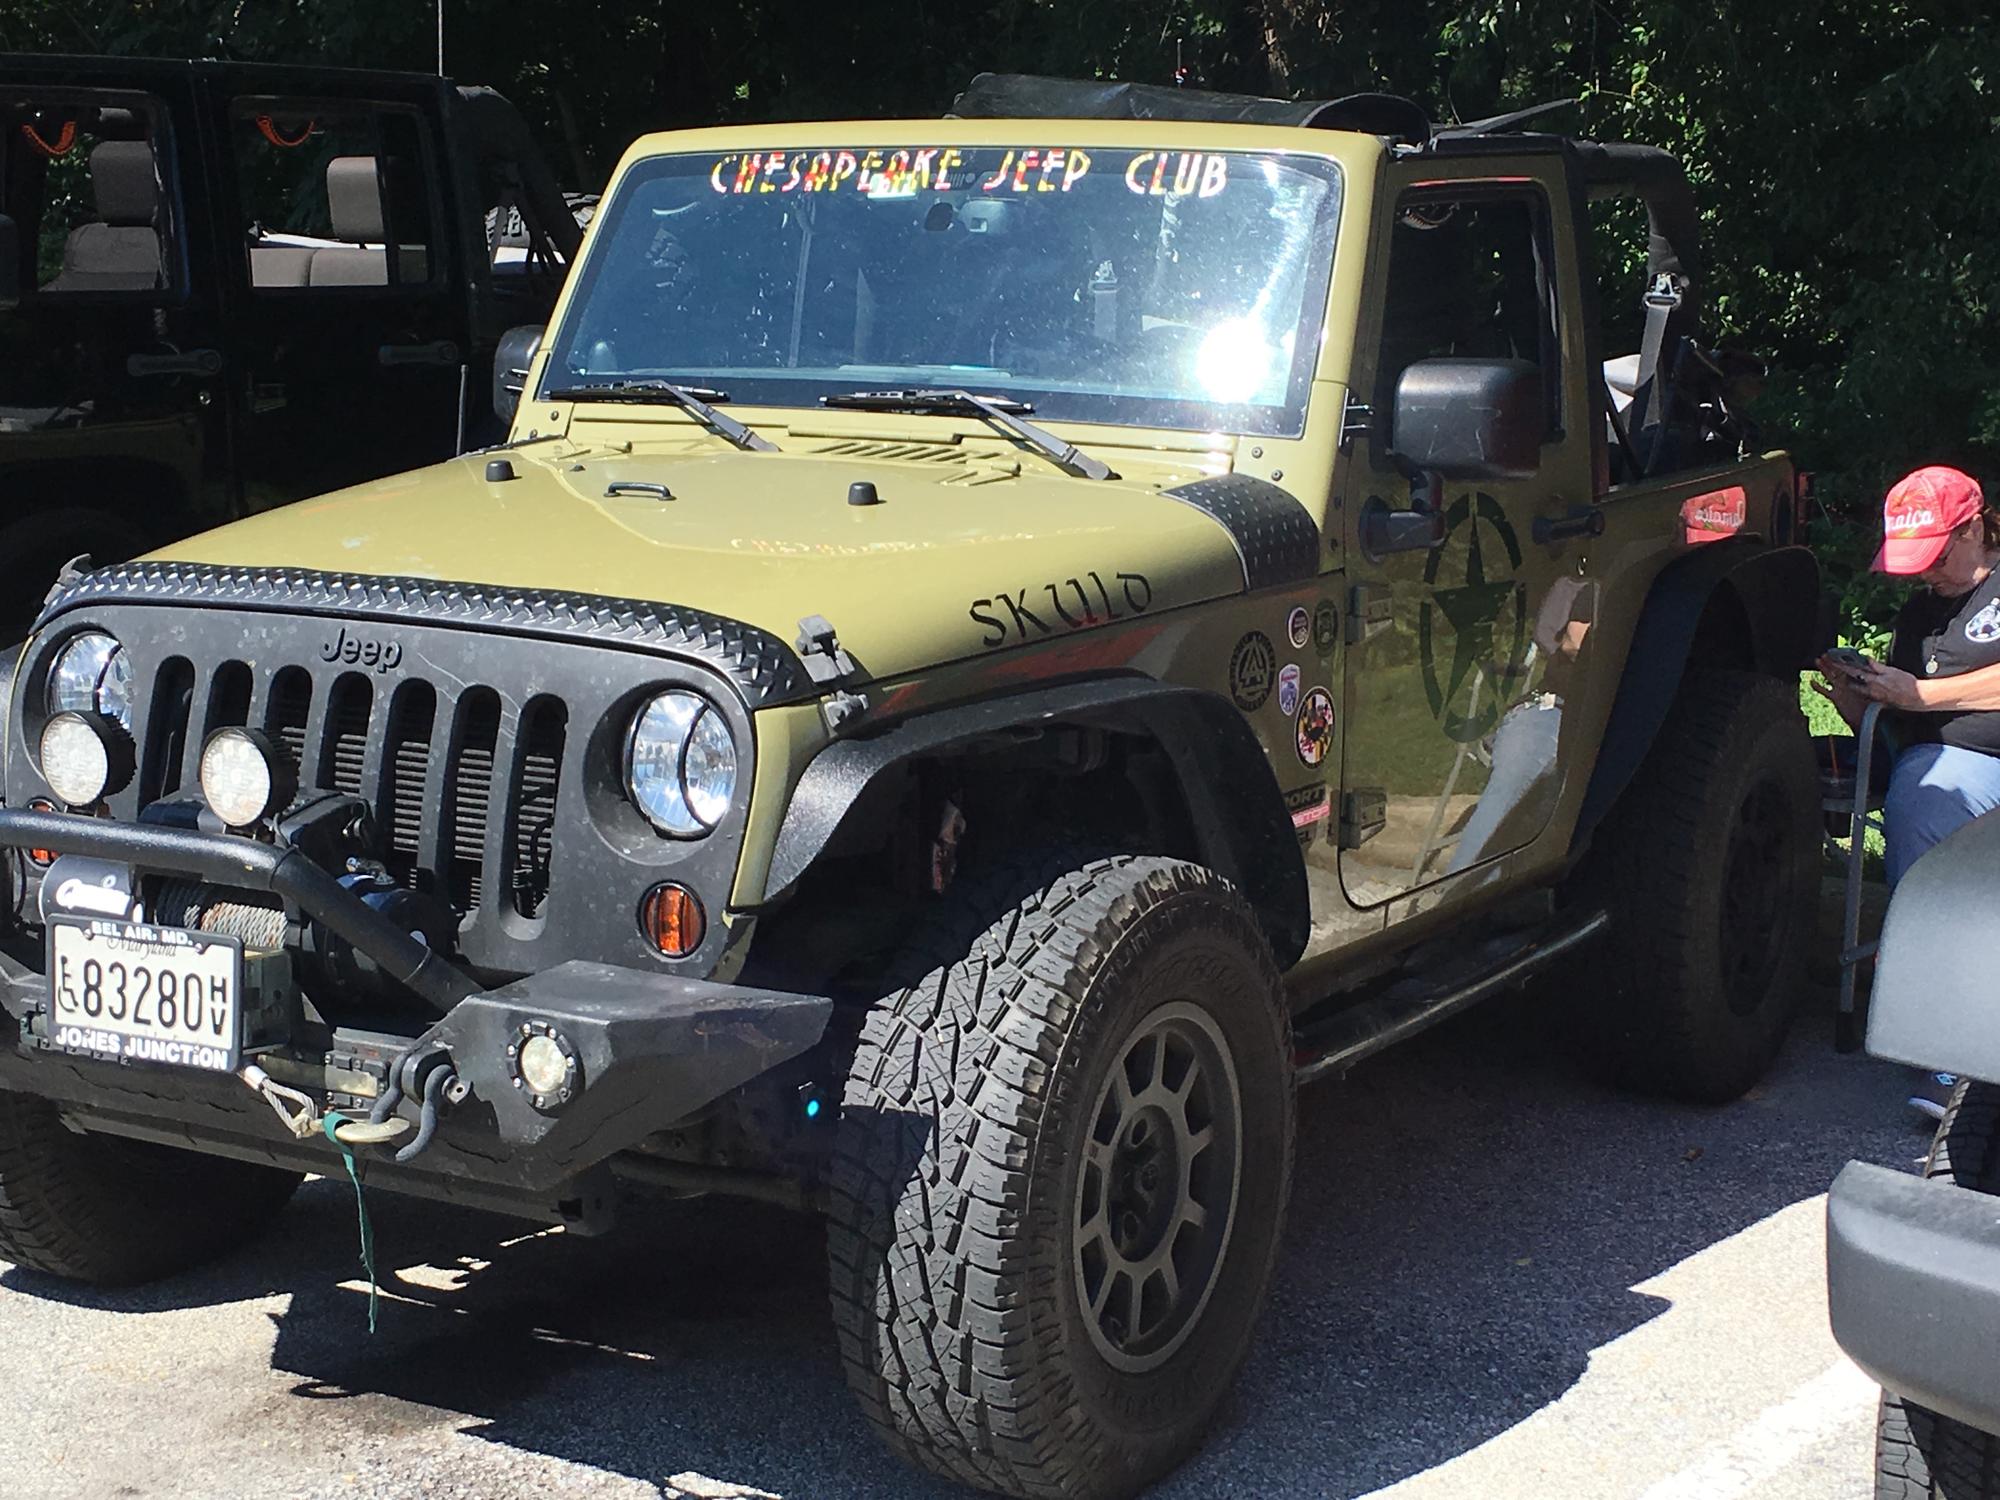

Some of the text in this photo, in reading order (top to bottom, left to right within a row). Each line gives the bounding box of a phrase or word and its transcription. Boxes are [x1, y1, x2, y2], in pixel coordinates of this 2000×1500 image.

[711, 148, 1228, 198] CHESAPEAKE JEEP CLUB
[1885, 506, 1934, 532] aica
[320, 628, 402, 674] Jeep
[91, 920, 121, 937] BEL
[161, 929, 193, 946] MD.
[83, 958, 203, 1031] 83280
[55, 1026, 228, 1070] JONES JUNCTION
